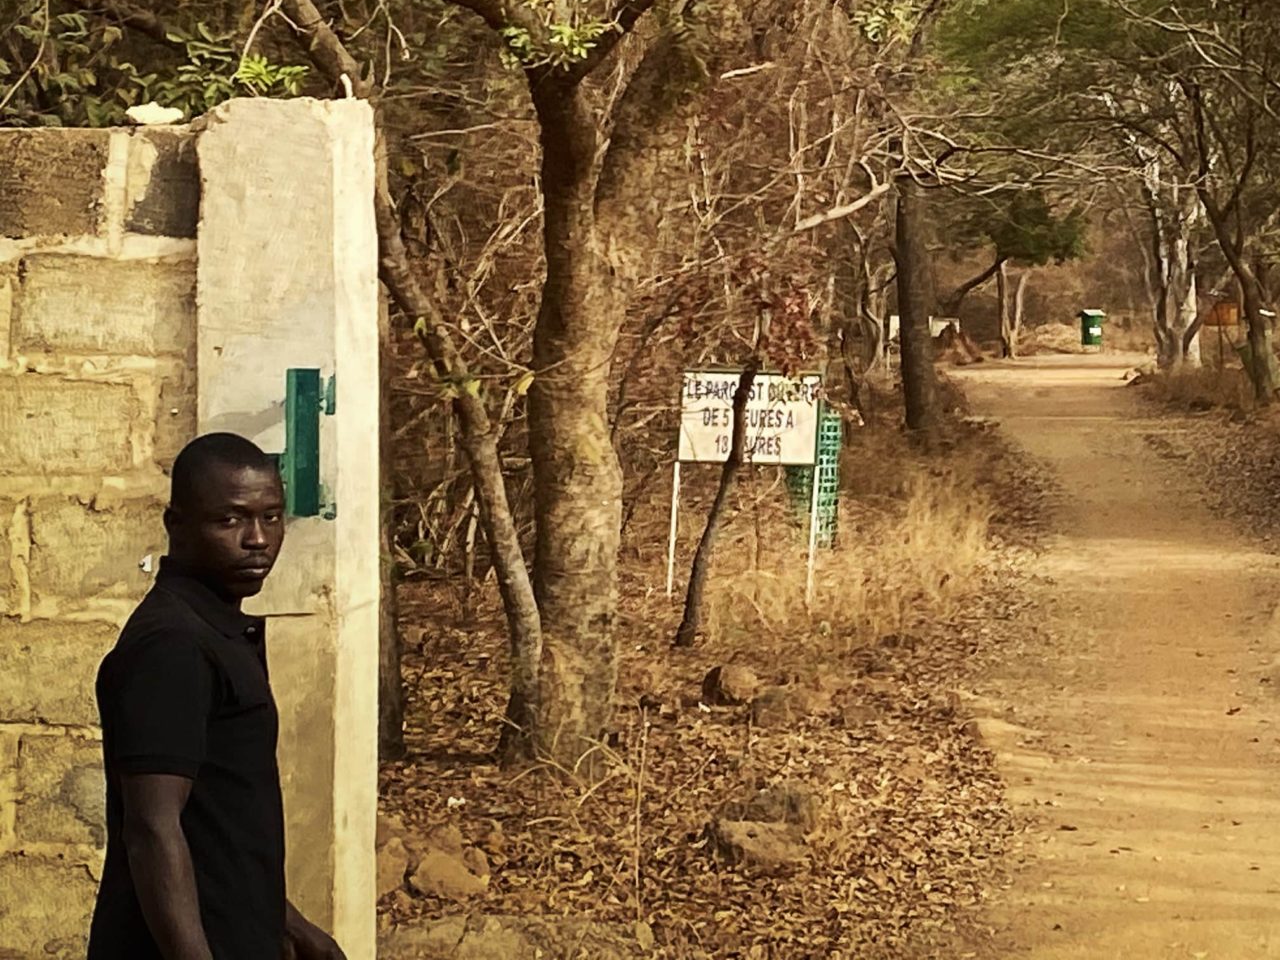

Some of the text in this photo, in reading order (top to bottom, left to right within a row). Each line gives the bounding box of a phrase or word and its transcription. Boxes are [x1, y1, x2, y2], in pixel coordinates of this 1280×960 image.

[686, 380, 701, 400] LE
[704, 381, 737, 401] PARC
[747, 382, 764, 401] ST
[702, 407, 795, 429] DE 5 EURES A
